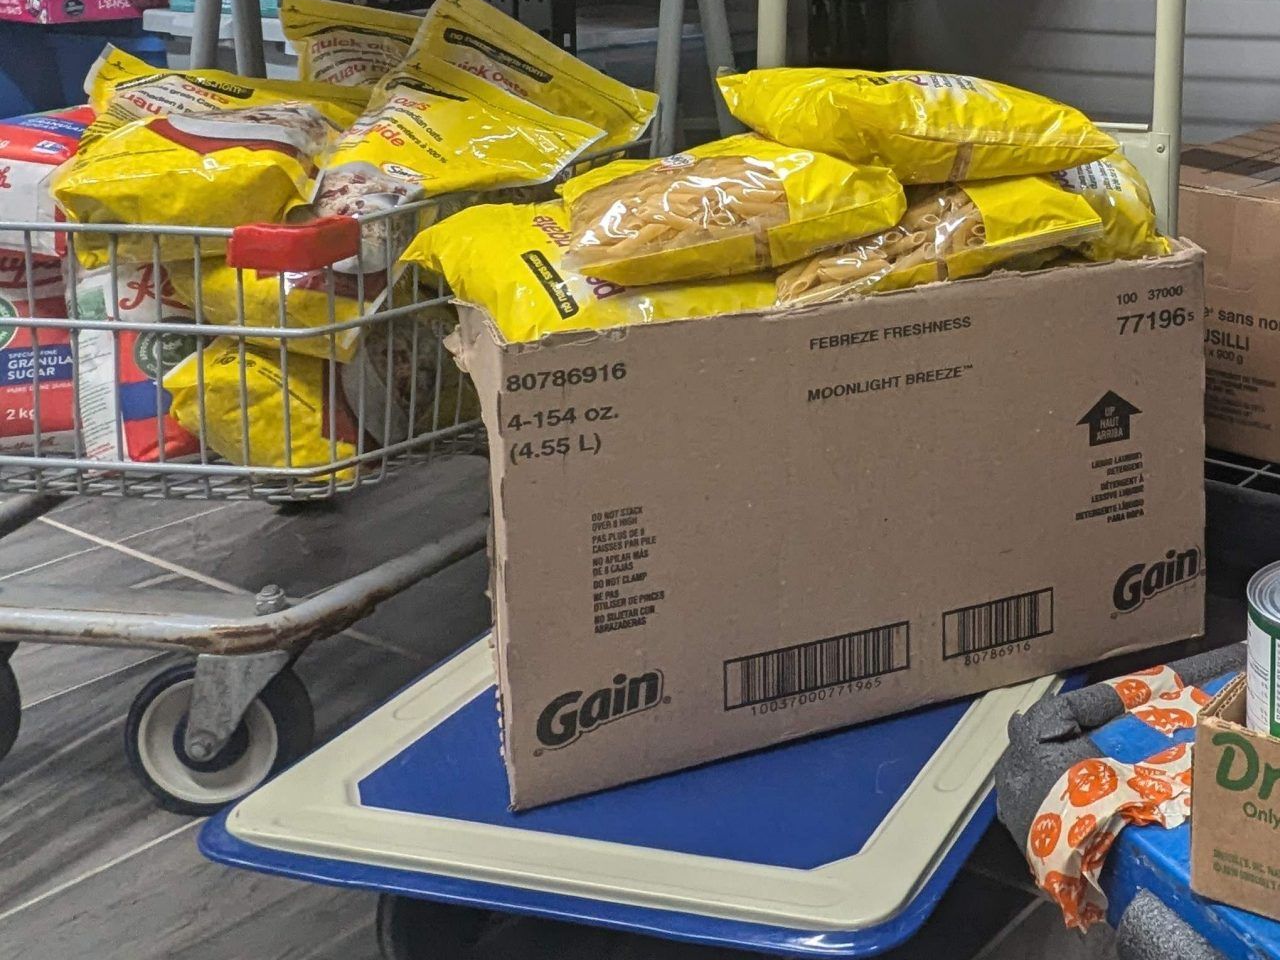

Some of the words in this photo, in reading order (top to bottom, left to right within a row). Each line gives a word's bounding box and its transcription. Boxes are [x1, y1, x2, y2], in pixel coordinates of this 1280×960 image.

[559, 300, 575, 315] no
[1117, 291, 1138, 306] 100
[1147, 285, 1184, 301] 37000
[1218, 308, 1255, 327] sans
[809, 327, 880, 352] FEBREZE
[883, 315, 972, 339] FRESHNESS
[1216, 348, 1236, 362] 900
[8, 366, 56, 381] SUGAR
[506, 362, 628, 392] 80786916
[807, 375, 902, 403] MOONLIGHT
[6, 409, 16, 421] 2
[507, 406, 577, 432] 4-154
[509, 435, 571, 466] (4.55
[579, 433, 602, 456] L)
[1112, 547, 1199, 613] Gain
[963, 640, 1032, 668] 80786916
[536, 669, 659, 748] Gain
[750, 677, 884, 717] 10037000771965
